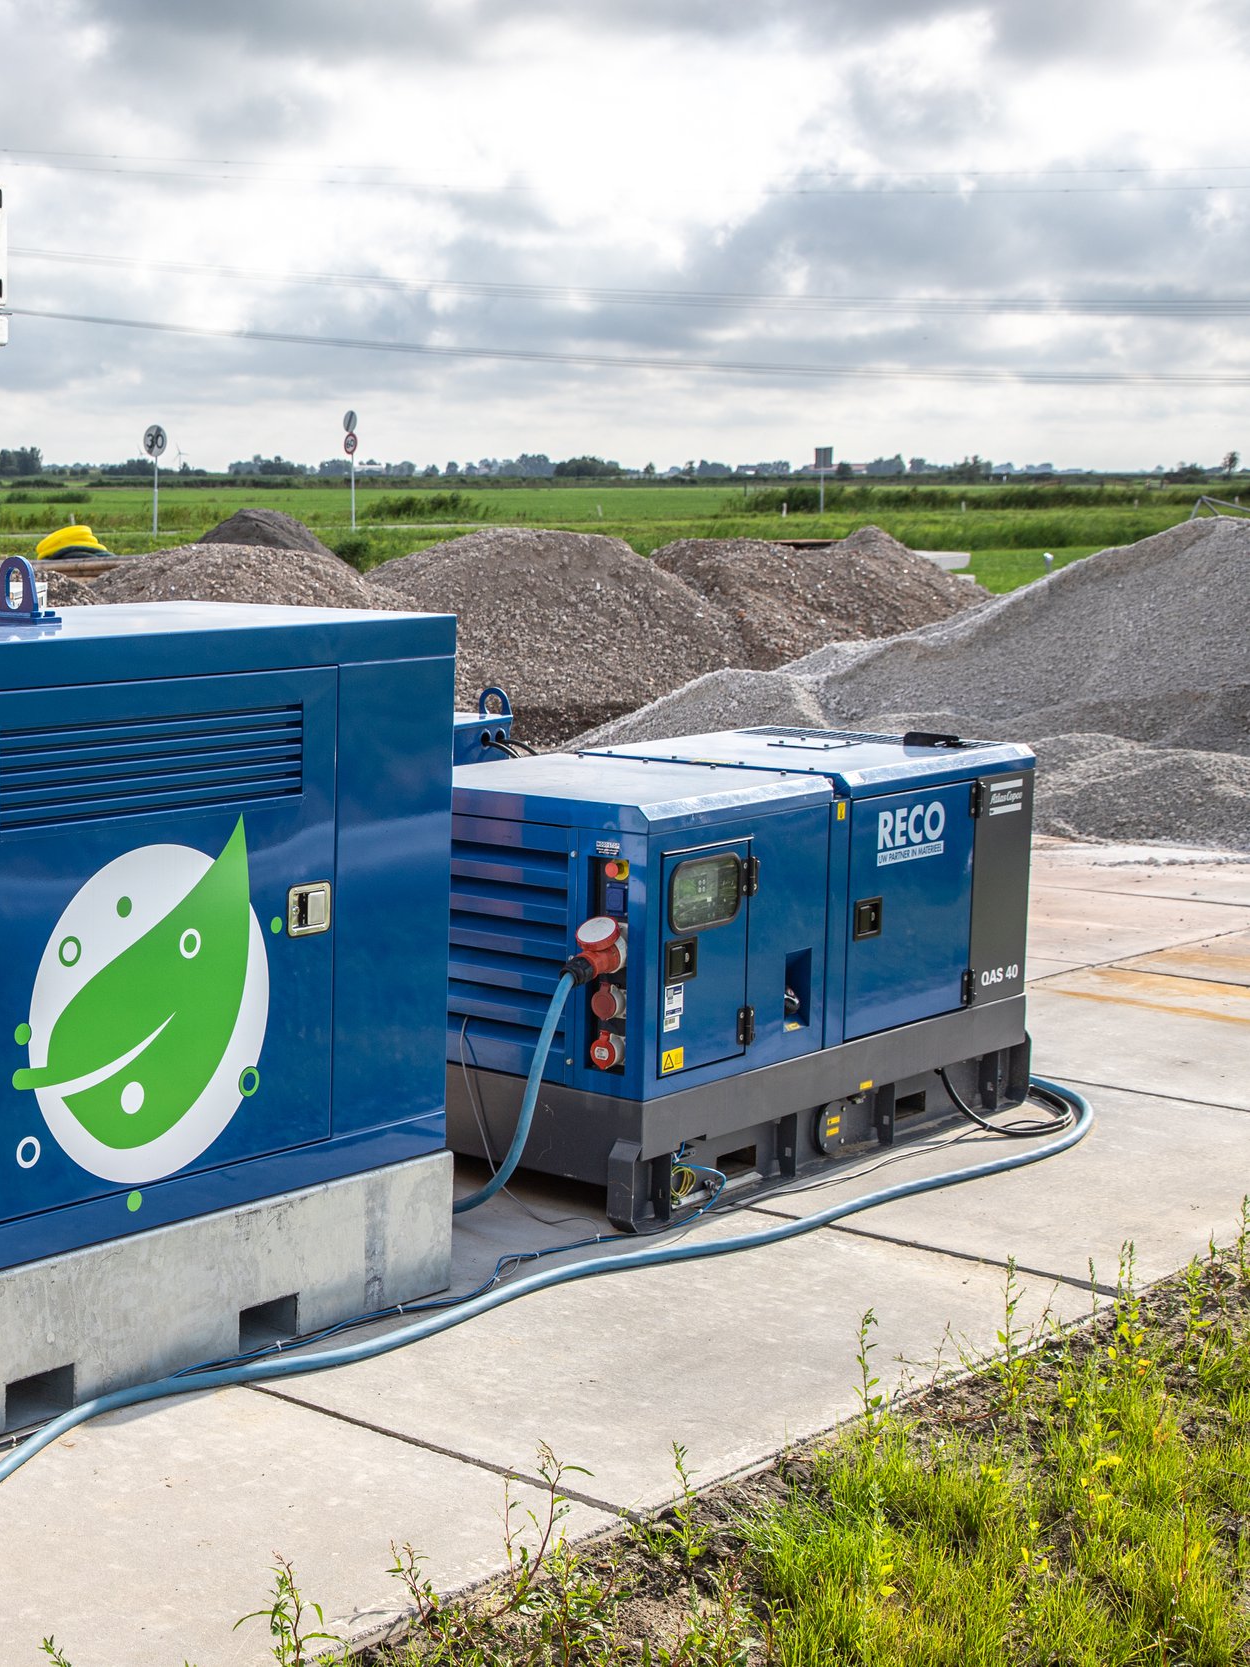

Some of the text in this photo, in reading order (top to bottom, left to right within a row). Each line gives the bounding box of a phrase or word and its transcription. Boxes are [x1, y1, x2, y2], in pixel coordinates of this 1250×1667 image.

[146, 433, 165, 449] 30
[877, 801, 946, 850] RECO
[878, 843, 942, 865] UW PARTNER IN MATERIEEL
[981, 964, 1019, 987] QAS 40
